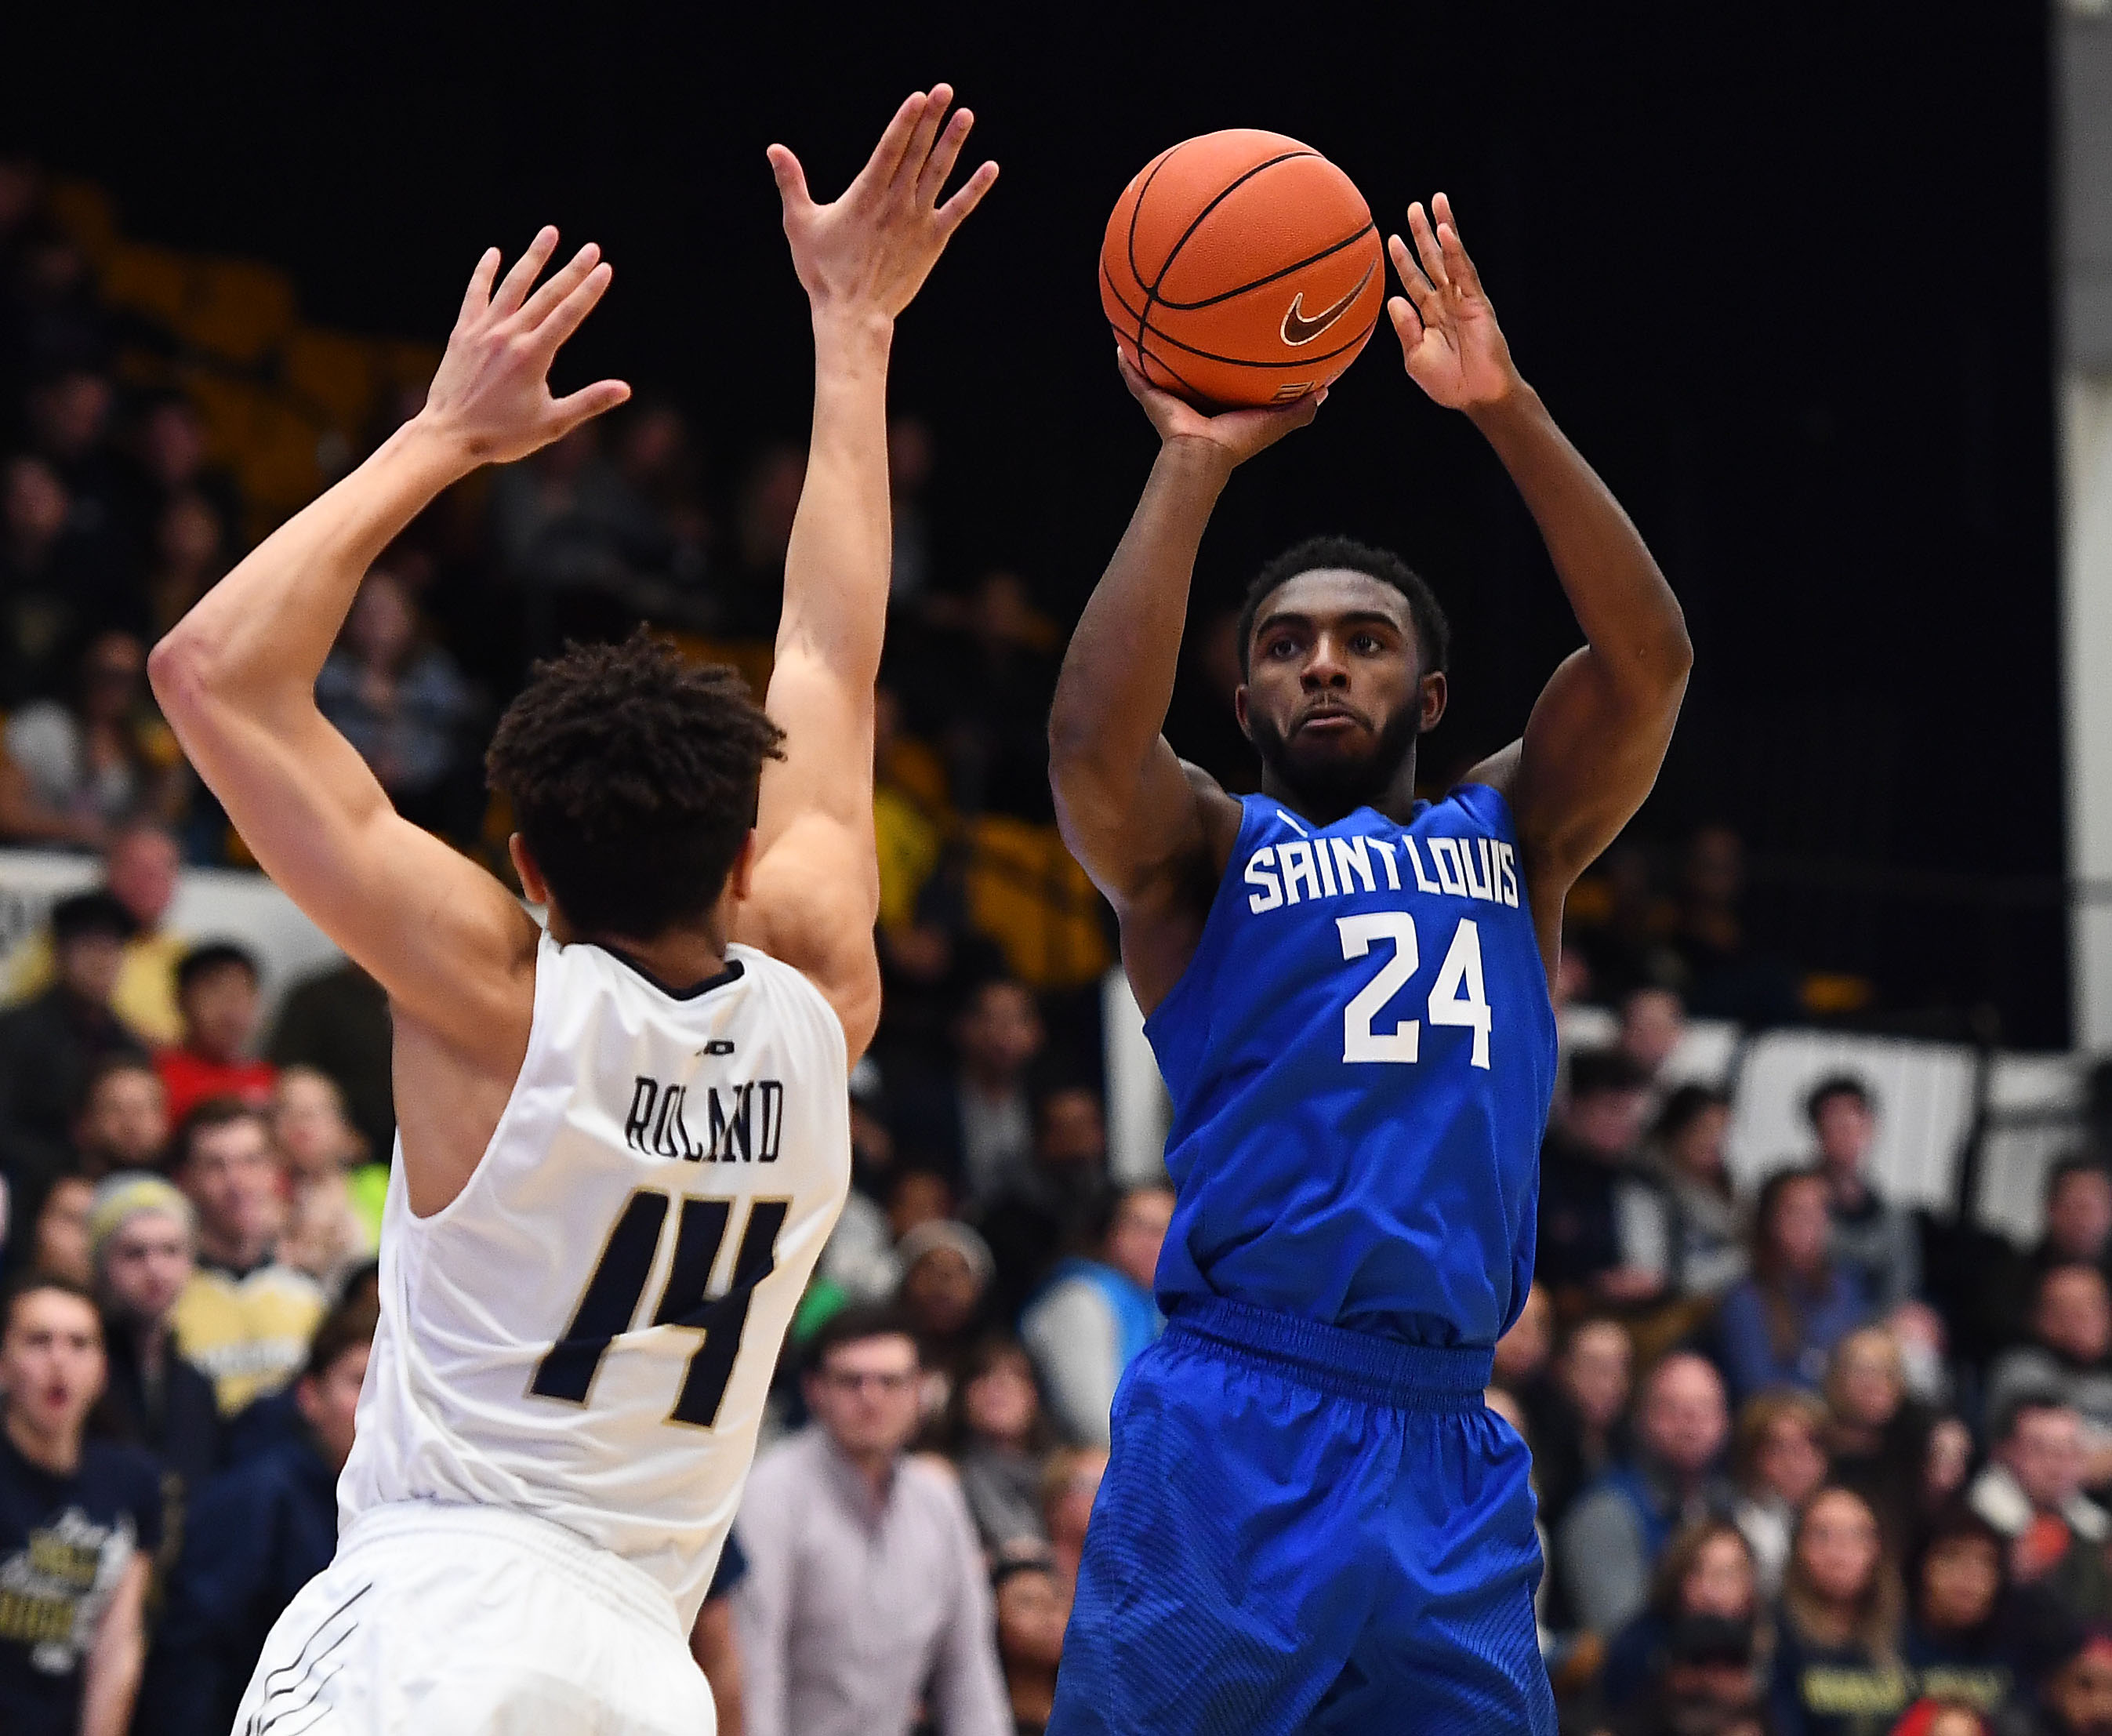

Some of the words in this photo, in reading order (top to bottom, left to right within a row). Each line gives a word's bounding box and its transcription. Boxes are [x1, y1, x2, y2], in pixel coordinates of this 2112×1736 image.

[1245, 835, 1401, 914] SAINT
[1403, 834, 1519, 909] LOUIS
[1336, 911, 1492, 1070] 24
[625, 1075, 783, 1163] ROLAND
[523, 1185, 793, 1433] 14
